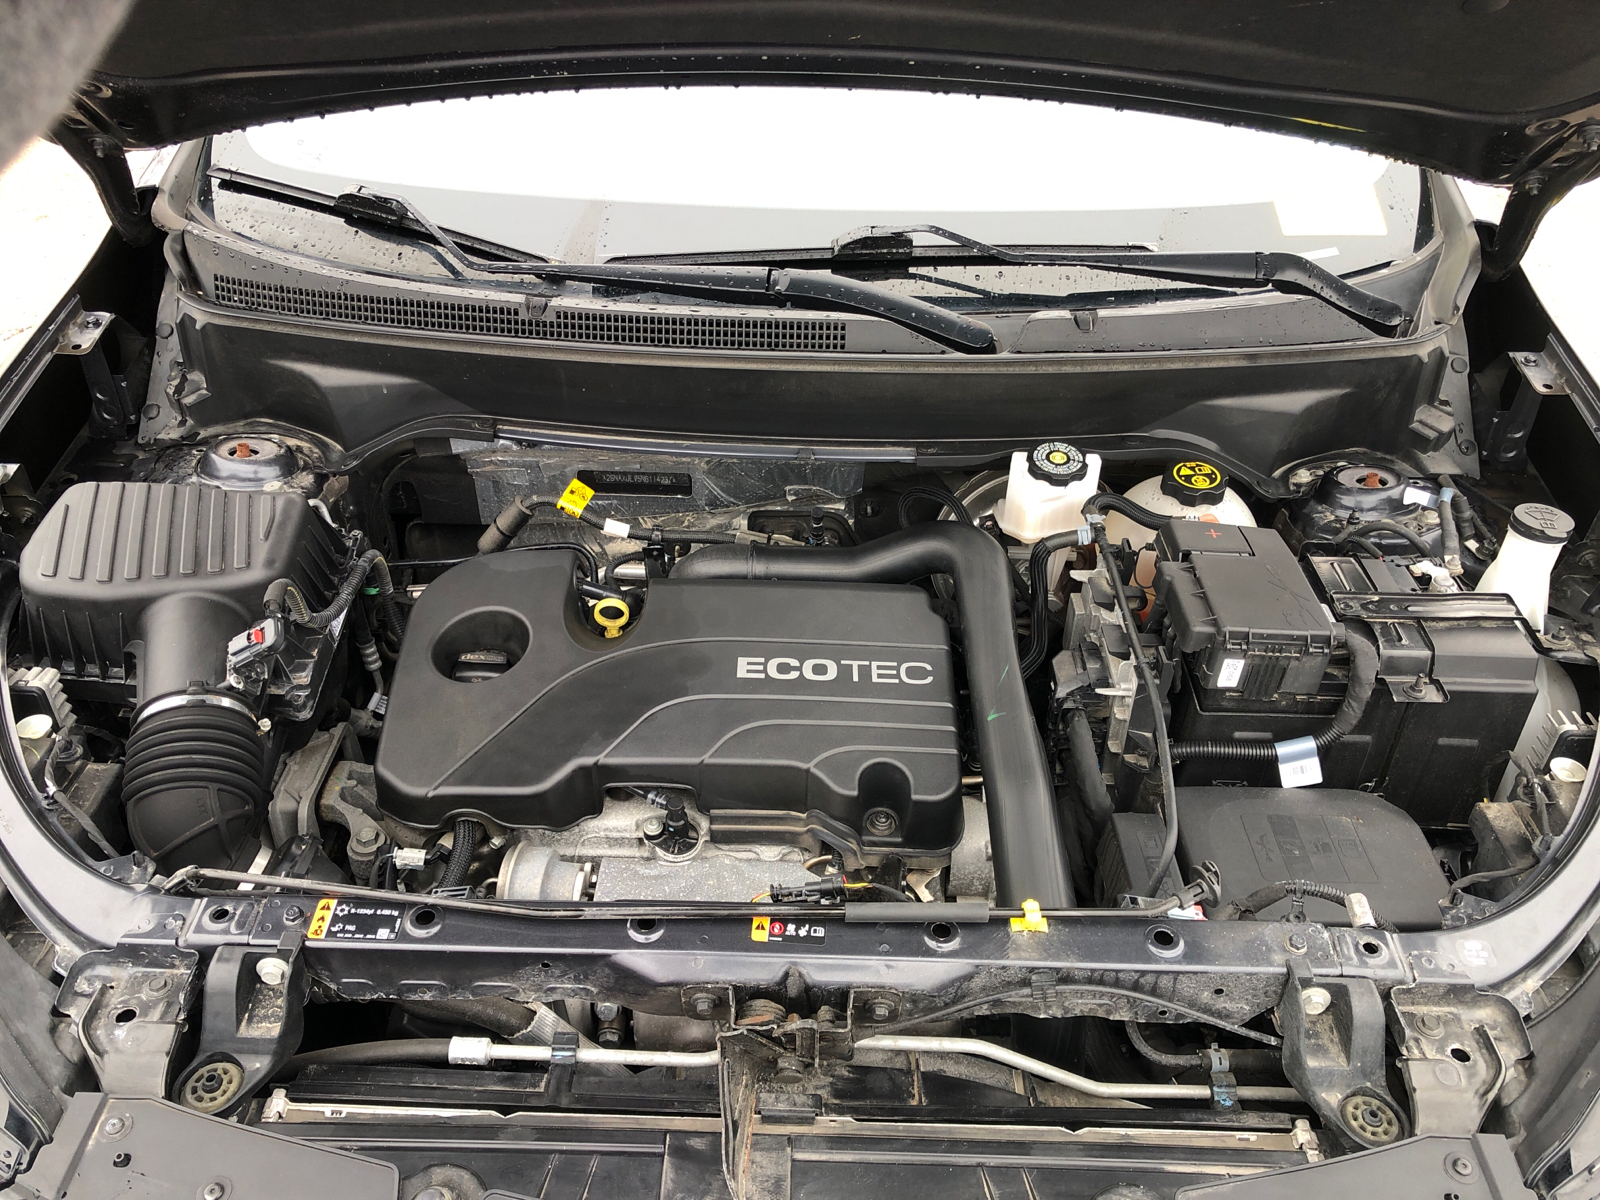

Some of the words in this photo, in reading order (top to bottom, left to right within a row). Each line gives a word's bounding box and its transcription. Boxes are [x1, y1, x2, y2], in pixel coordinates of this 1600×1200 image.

[461, 654, 503, 662] dexos
[736, 656, 934, 686] ECOTEC
[344, 924, 357, 932] PAG
